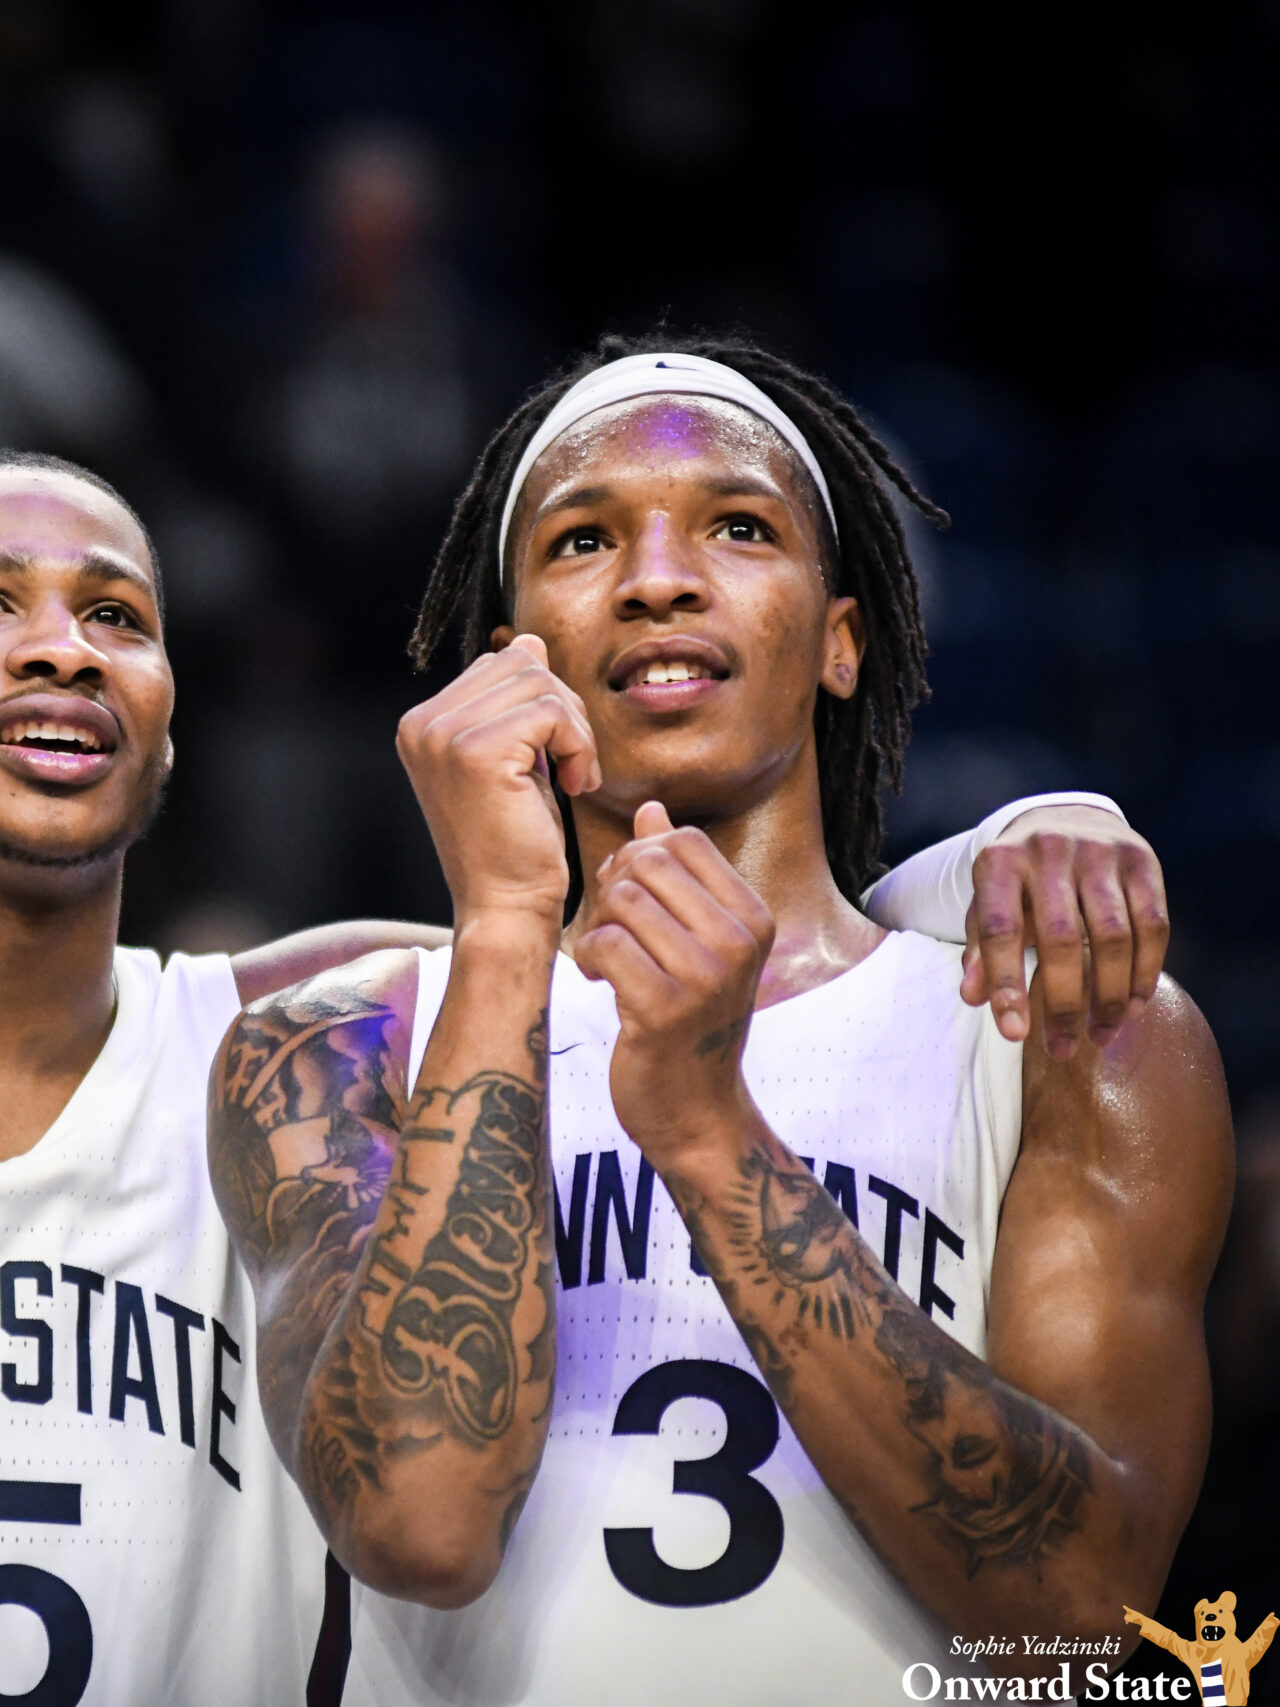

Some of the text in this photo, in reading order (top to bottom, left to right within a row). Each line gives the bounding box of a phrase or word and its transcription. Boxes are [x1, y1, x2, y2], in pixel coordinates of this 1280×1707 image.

[552, 1150, 655, 1291] NN
[0, 1261, 242, 1492] STATE
[603, 1359, 785, 1609] 3
